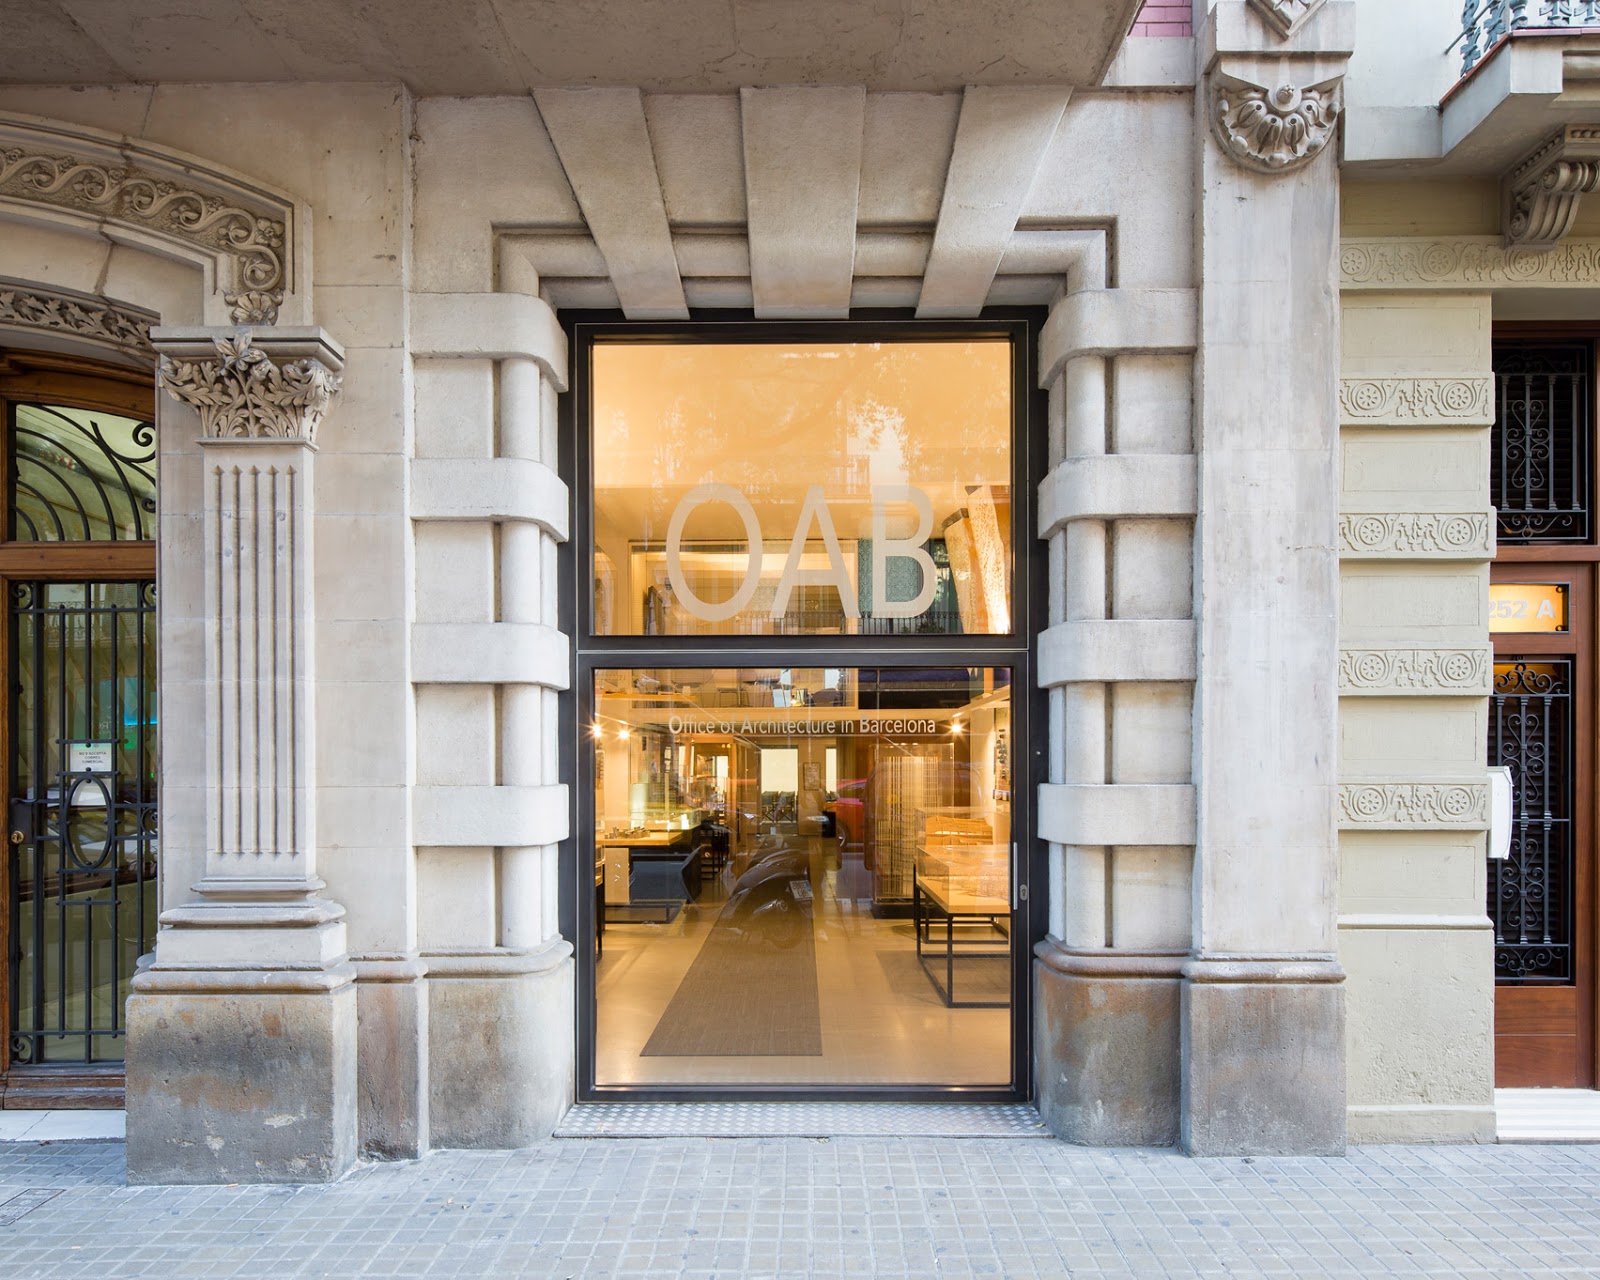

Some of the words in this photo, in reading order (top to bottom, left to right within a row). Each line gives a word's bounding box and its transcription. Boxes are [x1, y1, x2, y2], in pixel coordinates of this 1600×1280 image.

[665, 482, 938, 622] OAB
[1488, 599, 1528, 619] 252
[1536, 599, 1556, 619] A
[668, 714, 716, 735] Office
[720, 713, 736, 735] of
[740, 713, 837, 735] Architecture
[841, 715, 854, 733] in
[859, 713, 936, 734] Barcelona
